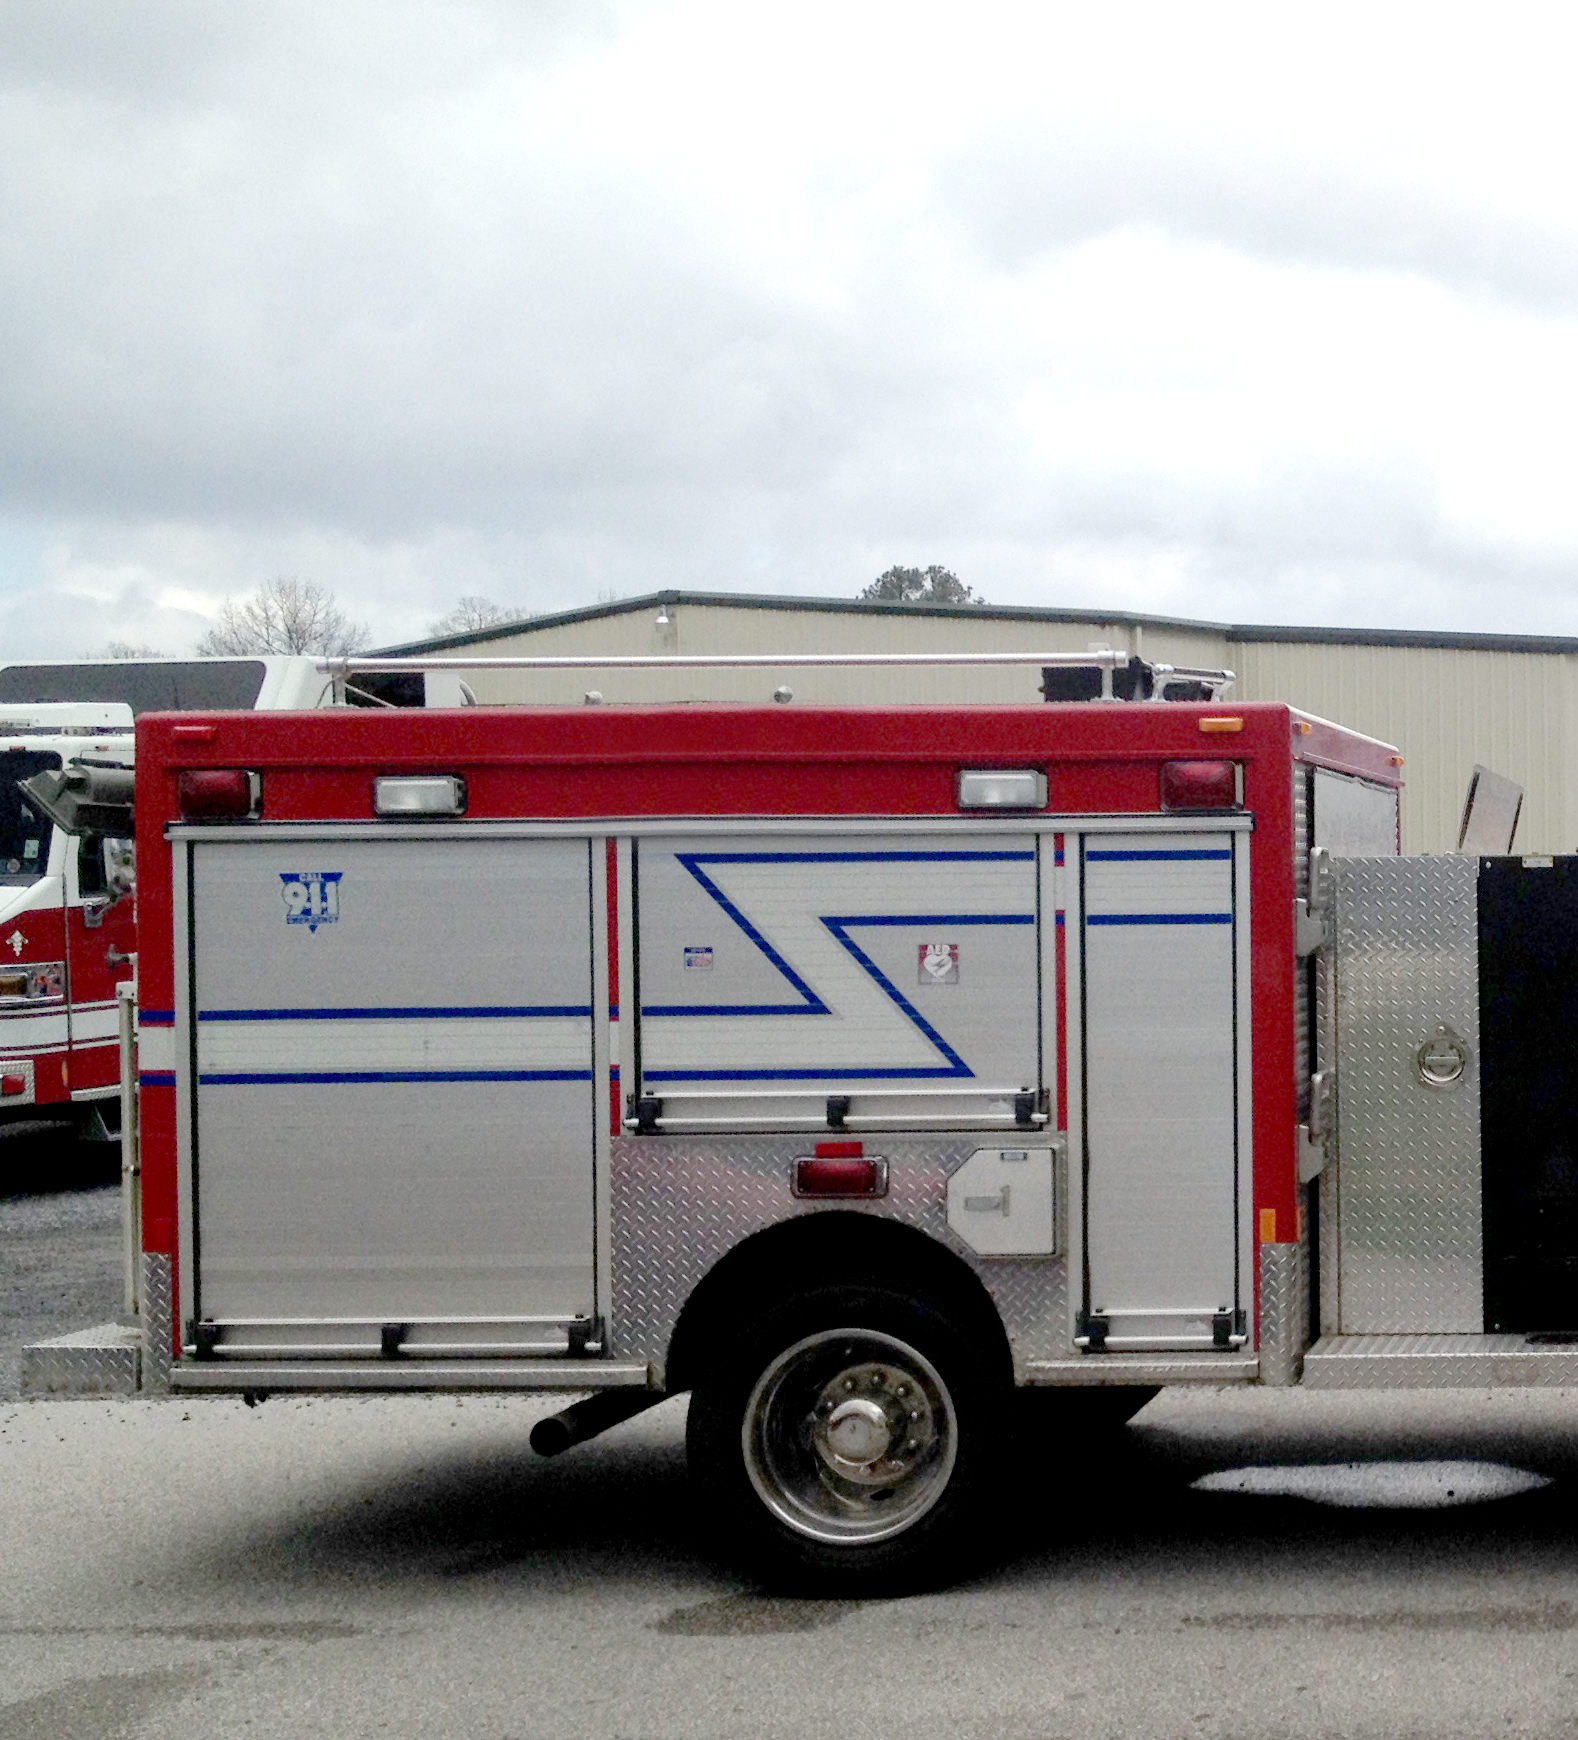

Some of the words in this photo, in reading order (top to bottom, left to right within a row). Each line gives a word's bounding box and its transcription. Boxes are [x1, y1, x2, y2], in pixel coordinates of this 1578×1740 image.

[299, 872, 323, 882] CALL
[282, 881, 339, 915] 911
[287, 915, 339, 924] EMERGENCY
[927, 944, 950, 955] AED
